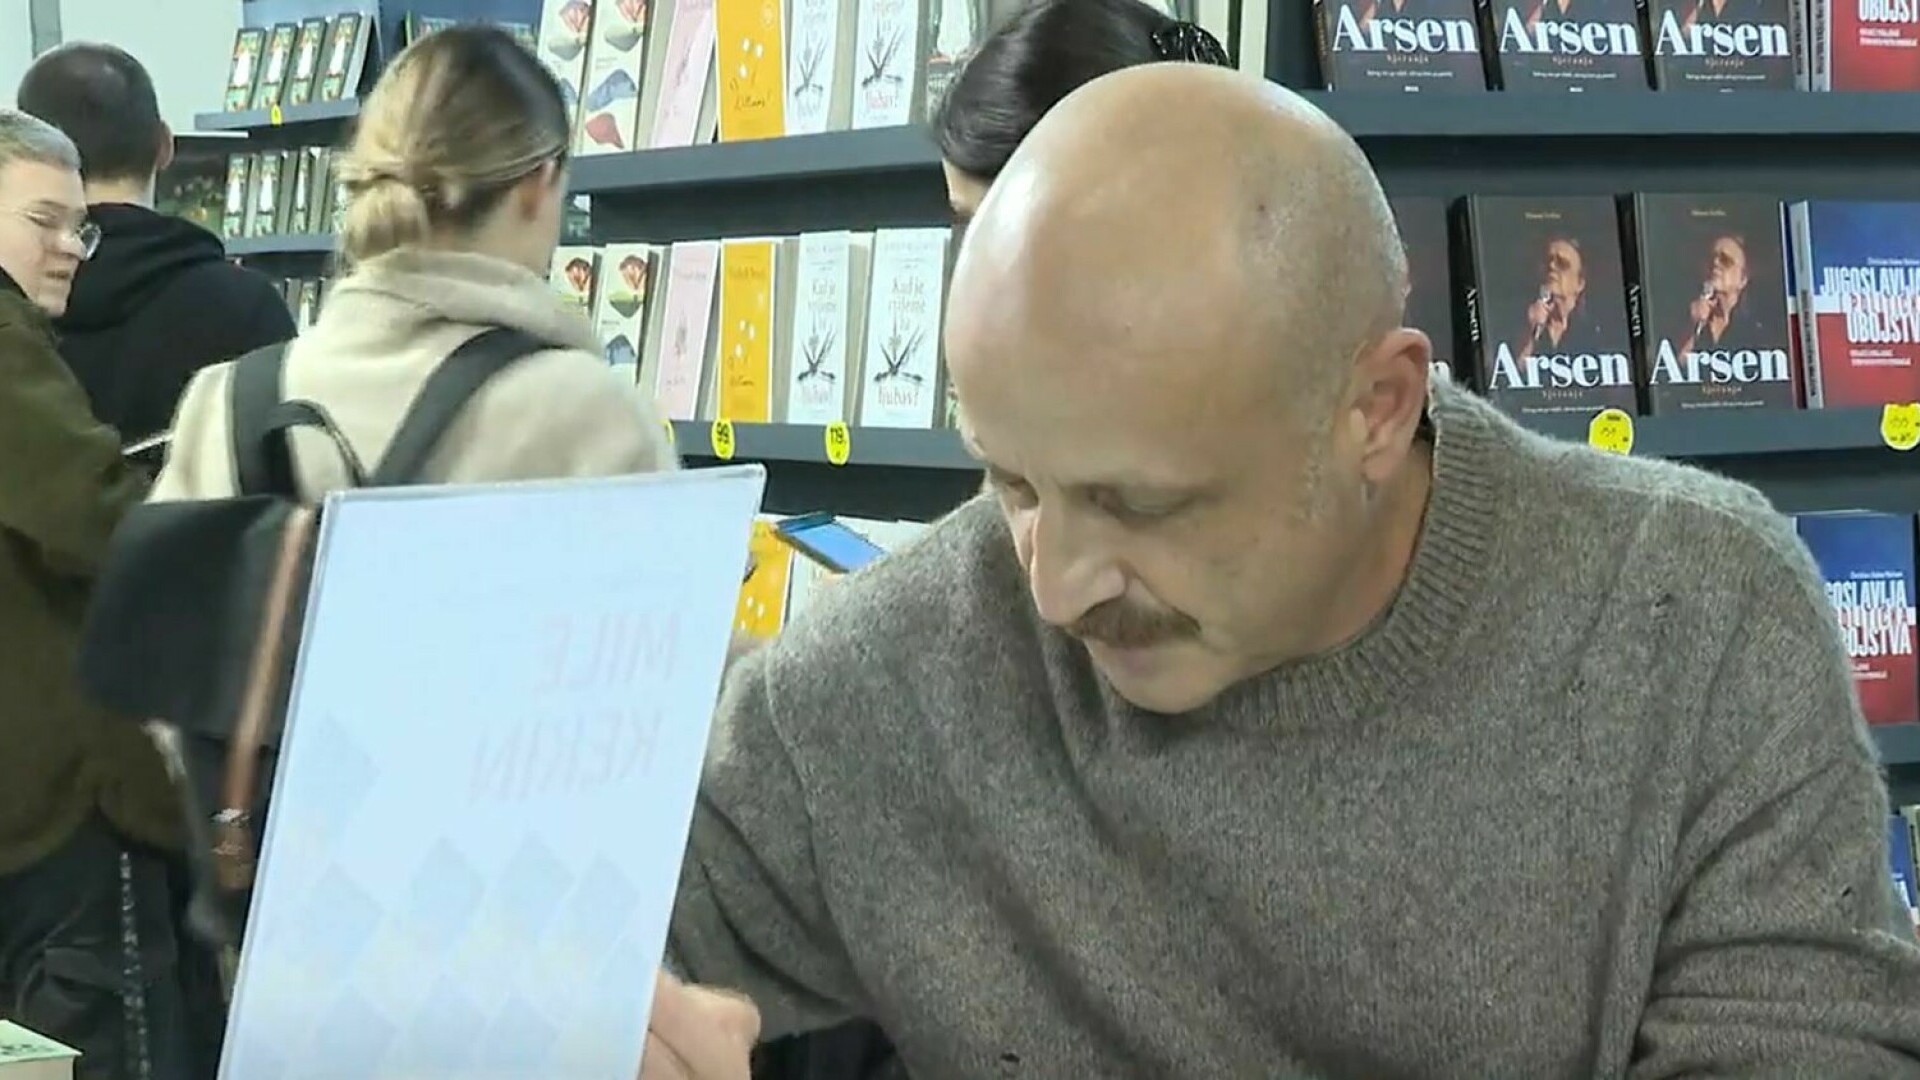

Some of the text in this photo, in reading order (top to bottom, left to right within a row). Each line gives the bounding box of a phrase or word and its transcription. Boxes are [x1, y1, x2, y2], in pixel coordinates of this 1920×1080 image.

[1332, 4, 1480, 53] Arsen
[1499, 5, 1642, 55] Arsen
[1653, 6, 1791, 56] Arsen
[1490, 342, 1633, 390] Arsen
[1650, 339, 1790, 387] Arsen
